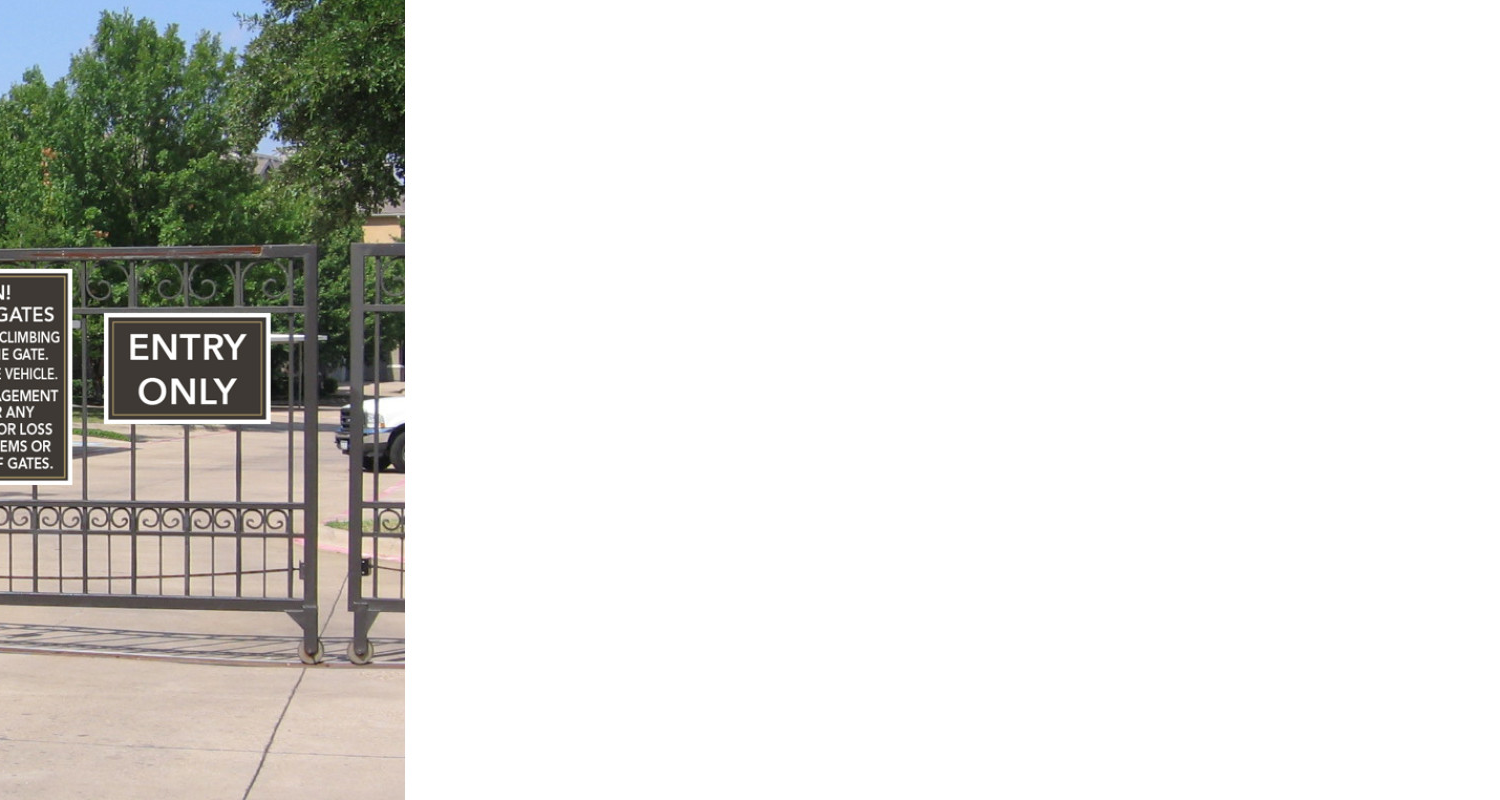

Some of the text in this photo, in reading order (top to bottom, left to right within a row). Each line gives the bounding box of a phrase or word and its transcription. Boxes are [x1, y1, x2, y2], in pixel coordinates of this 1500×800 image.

[0, 331, 60, 343] CLIMBING
[130, 334, 247, 360] ENTRY
[13, 348, 48, 360] GATE.
[5, 368, 58, 380] VEHICLE.
[138, 378, 237, 405] ONLY
[6, 406, 34, 418] ANY
[20, 423, 52, 435] LOSS
[31, 440, 51, 452] OR
[8, 457, 53, 469] GATES.
